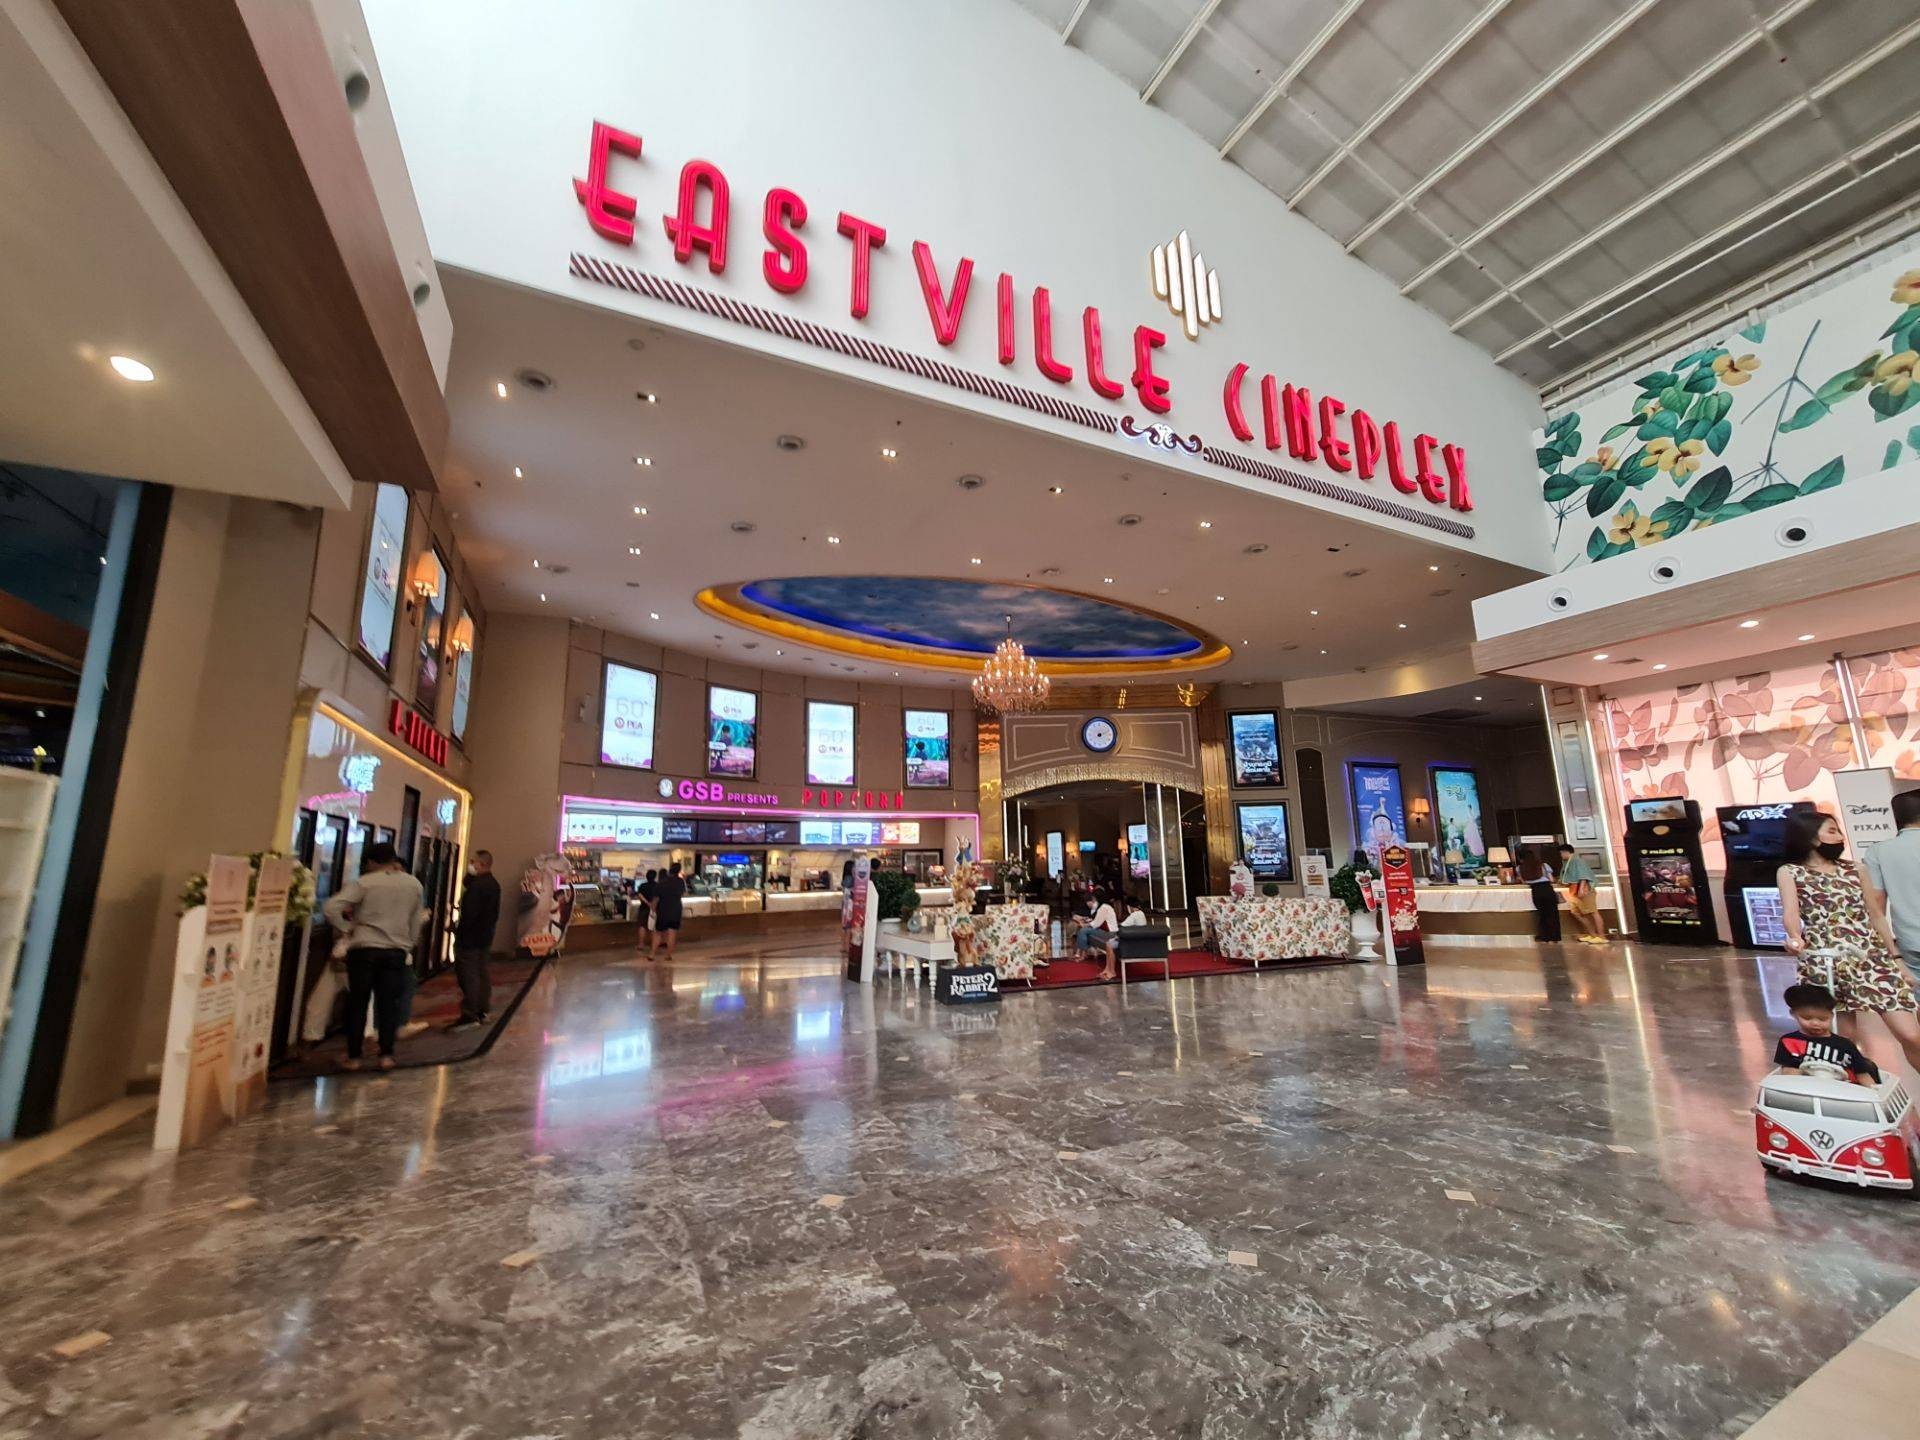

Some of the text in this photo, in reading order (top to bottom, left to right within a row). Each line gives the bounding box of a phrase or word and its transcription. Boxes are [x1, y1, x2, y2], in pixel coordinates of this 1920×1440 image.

[572, 118, 1474, 513] EASTVILLE CINEPLEX
[678, 779, 779, 805] GSB PRESENTS
[801, 788, 903, 810] POPCORN
[1853, 823, 1891, 832] PIXAR
[950, 972, 998, 996] RABBIT 2
[951, 974, 988, 986] PETER
